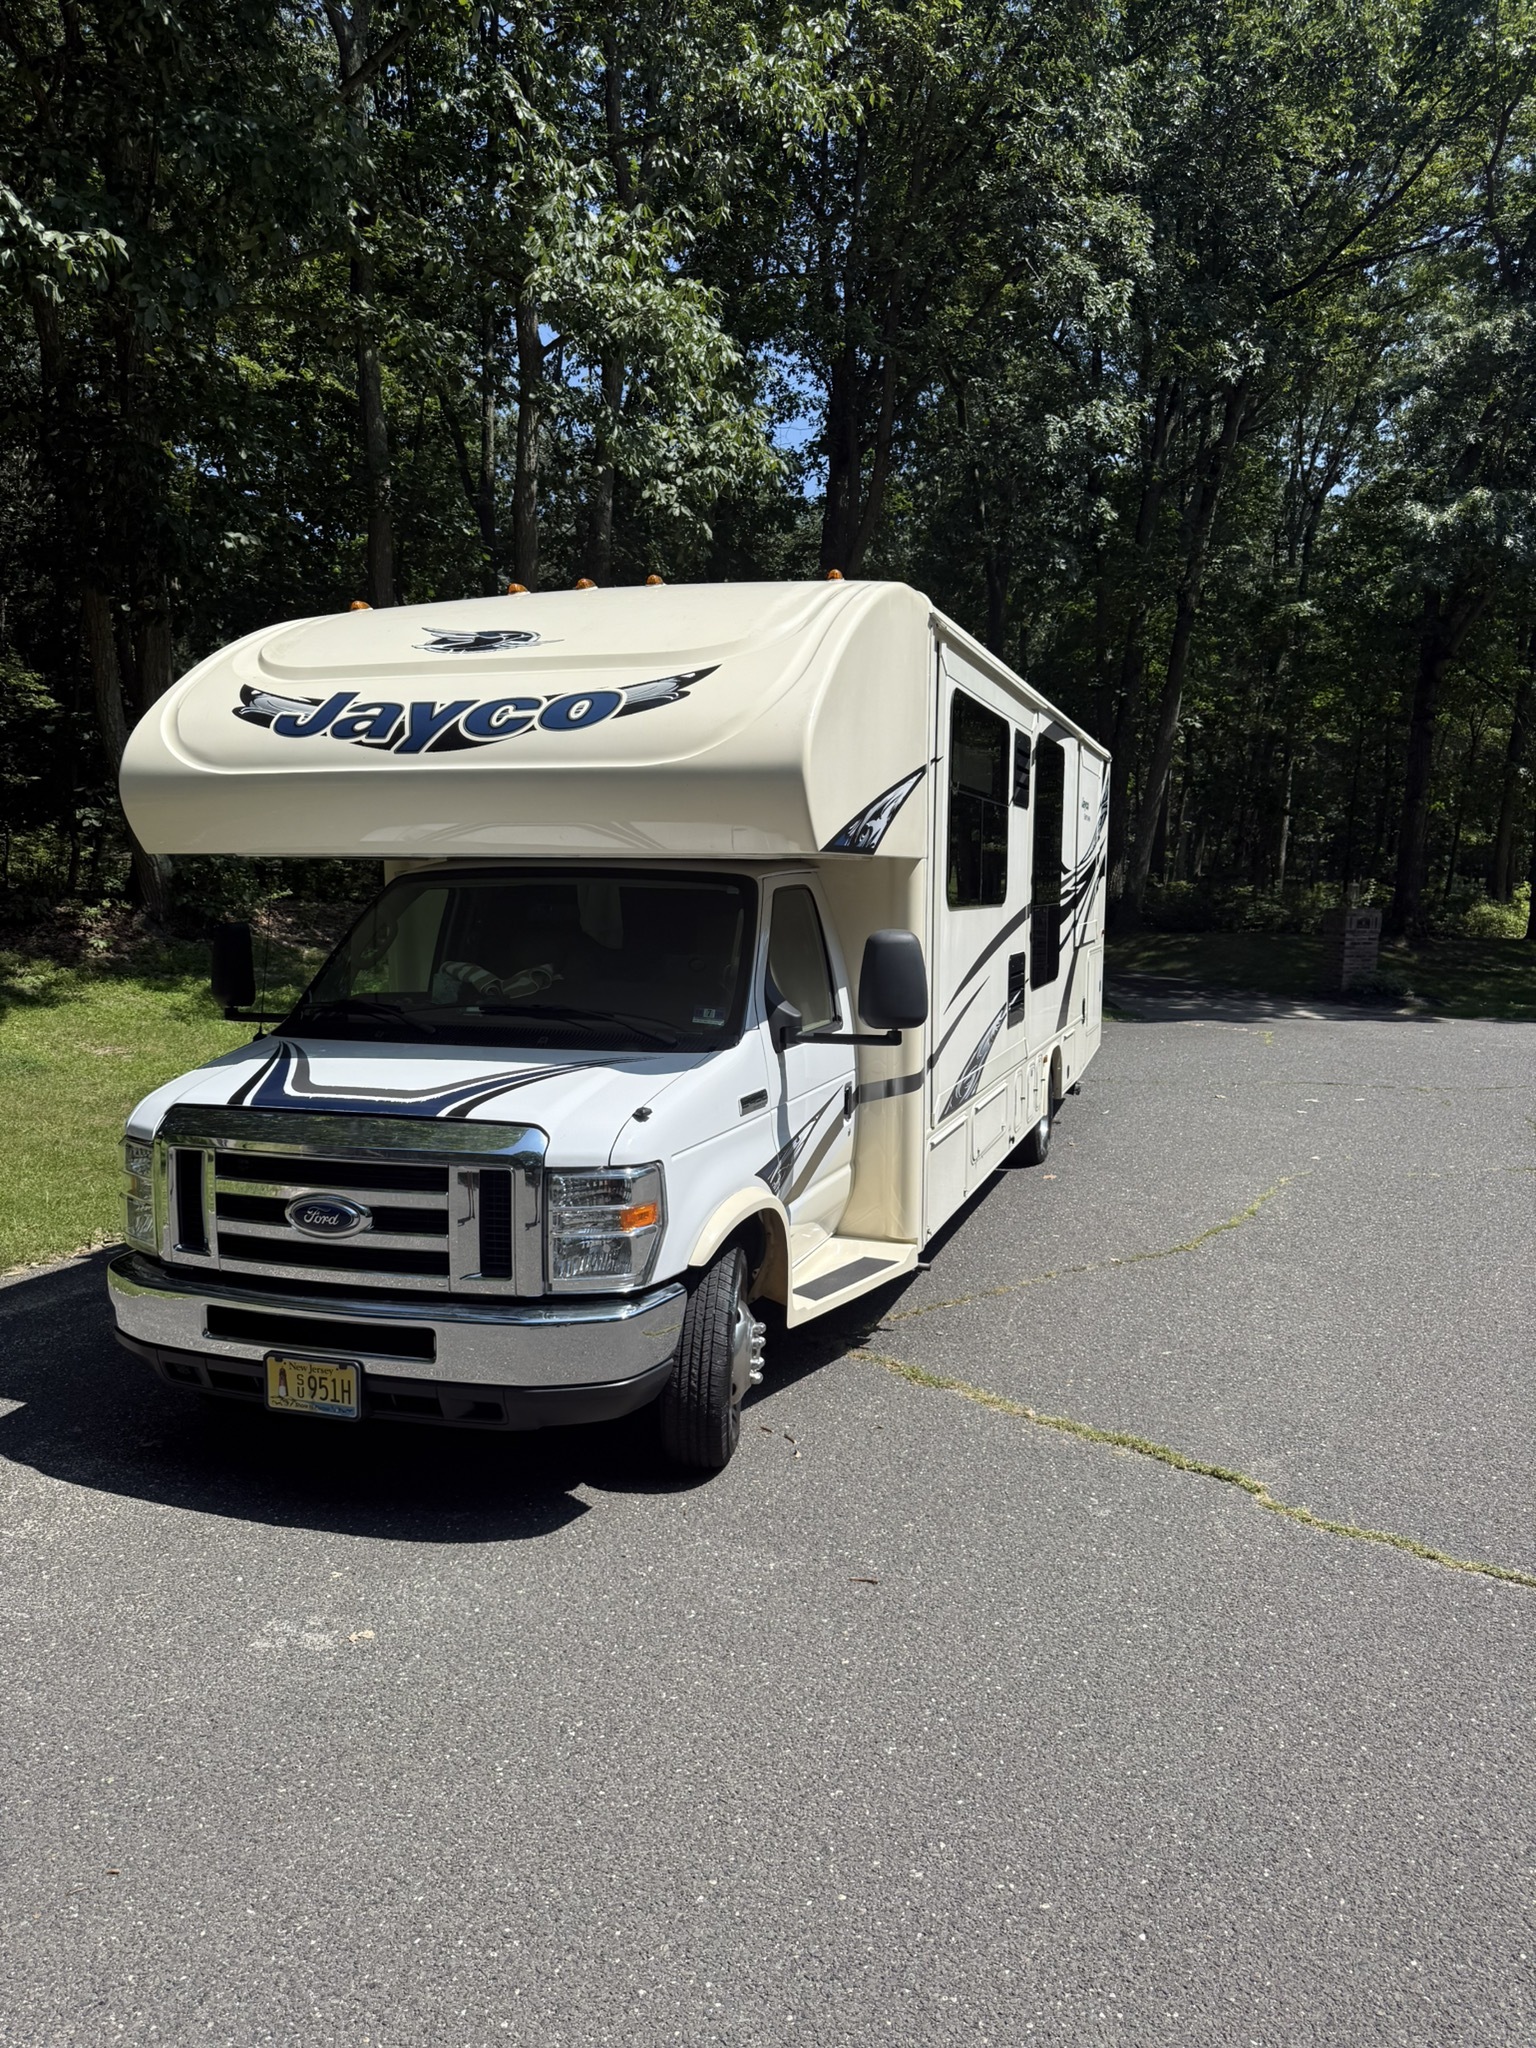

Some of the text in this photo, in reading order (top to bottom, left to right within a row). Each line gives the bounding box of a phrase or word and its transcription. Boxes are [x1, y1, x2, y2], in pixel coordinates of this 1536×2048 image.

[273, 689, 625, 755] Jayco
[303, 1206, 341, 1226] Ford
[288, 1361, 335, 1376] New Jersey
[307, 1374, 352, 1405] 951H
